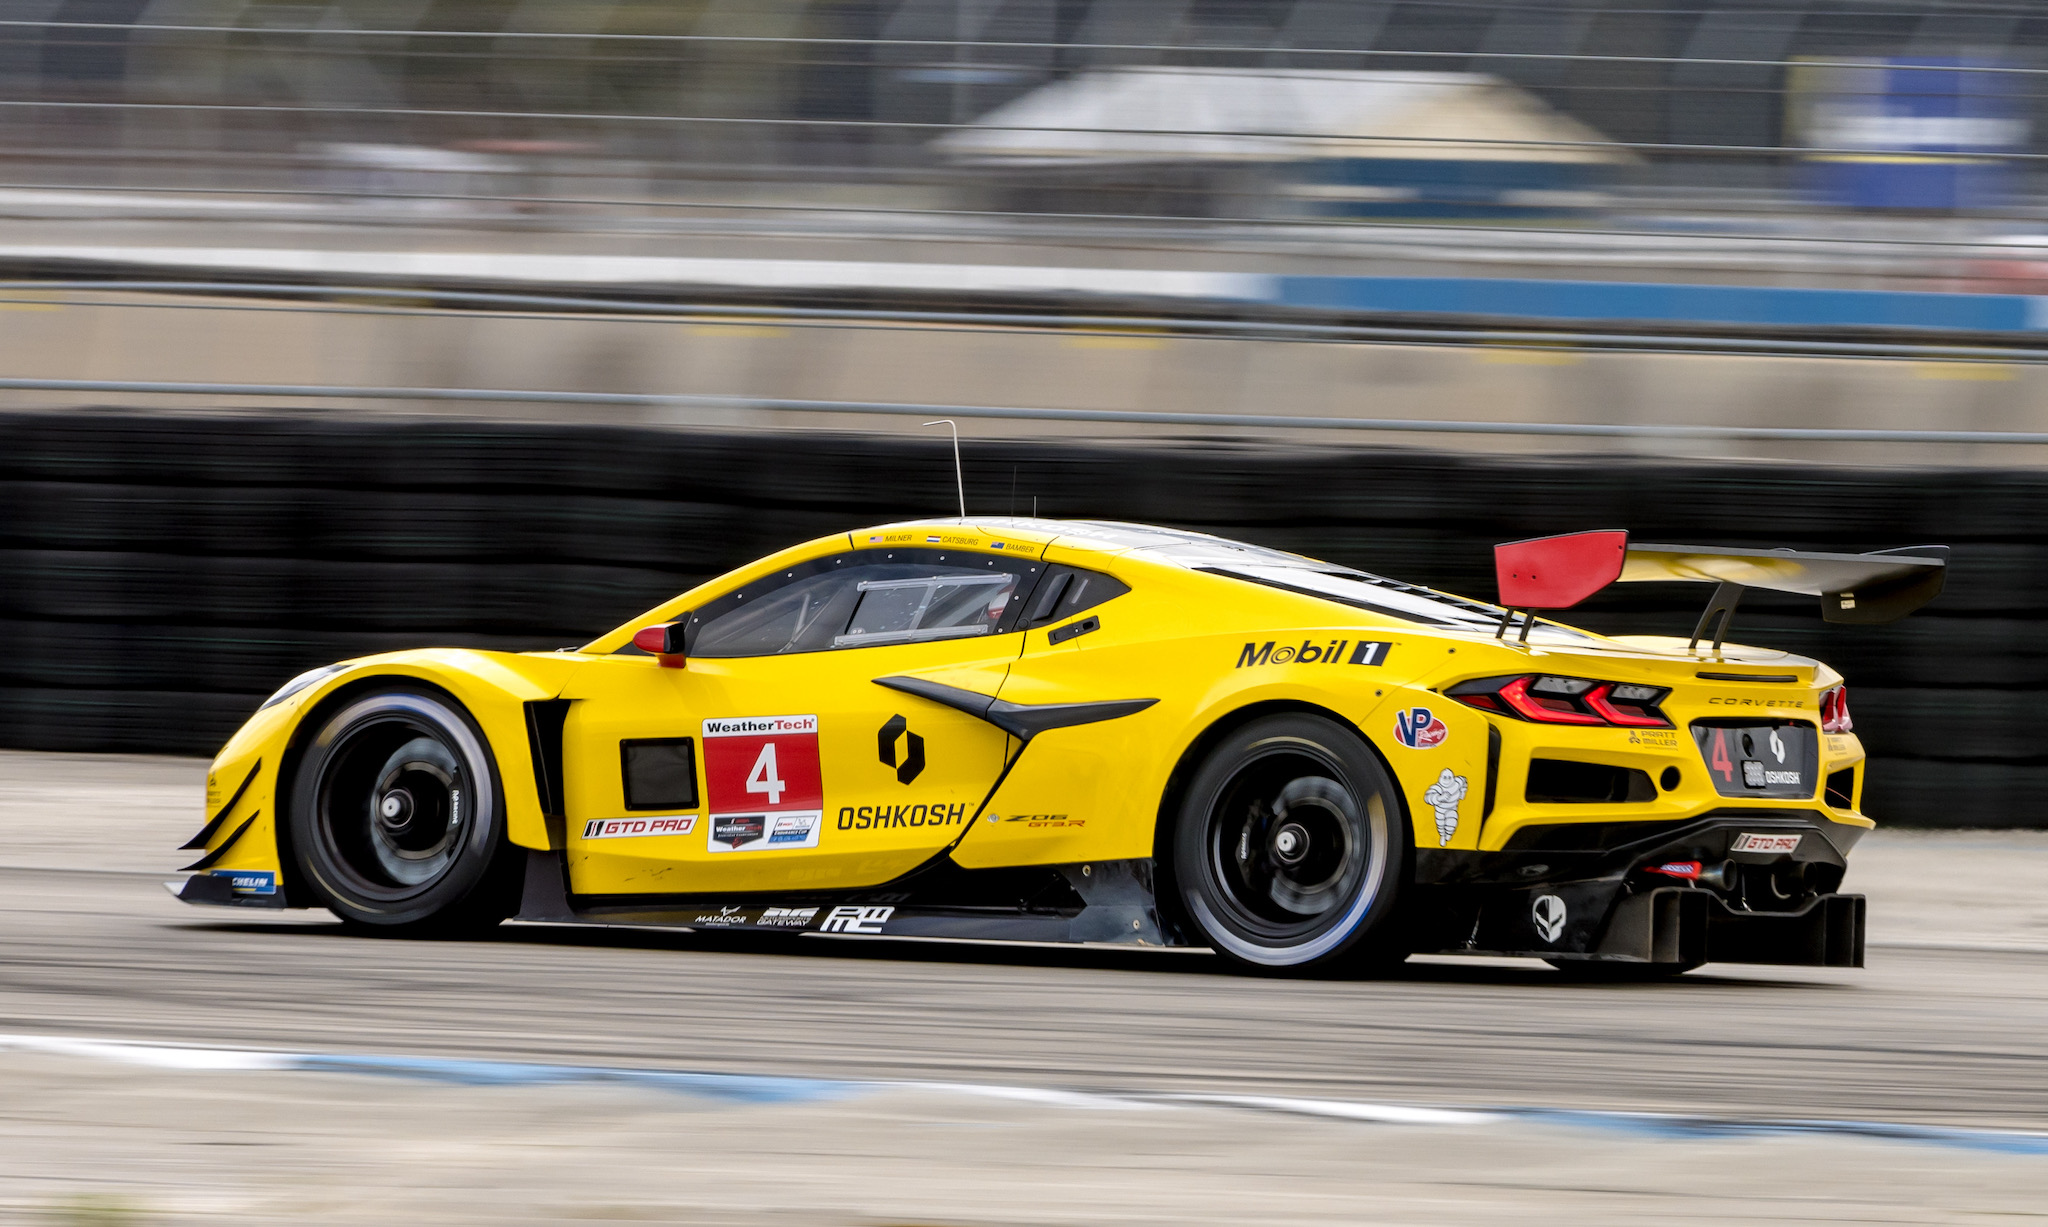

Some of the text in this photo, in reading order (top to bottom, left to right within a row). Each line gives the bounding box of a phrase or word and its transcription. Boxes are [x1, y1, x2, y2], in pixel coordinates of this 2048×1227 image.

[885, 534, 1035, 553] MILNER CATSBURG BAMBER
[1235, 640, 1380, 669] Mobil 1
[1708, 697, 1804, 708] CORVETTE
[707, 719, 812, 733] WeatherTech
[1398, 708, 1431, 747] VP
[1643, 738, 1678, 746] MILLER
[1712, 728, 1733, 783] 4
[746, 743, 785, 804] 4
[1765, 770, 1800, 785] OSHKOSH
[837, 803, 965, 830] OSHKOSH
[1004, 814, 1068, 822] Z06
[604, 819, 692, 834] GTD PRO
[1747, 837, 1797, 849] GTD PRO
[232, 877, 268, 888] CHELIN
[694, 915, 747, 924] MATADOR
[756, 918, 811, 926] GATEWAY
